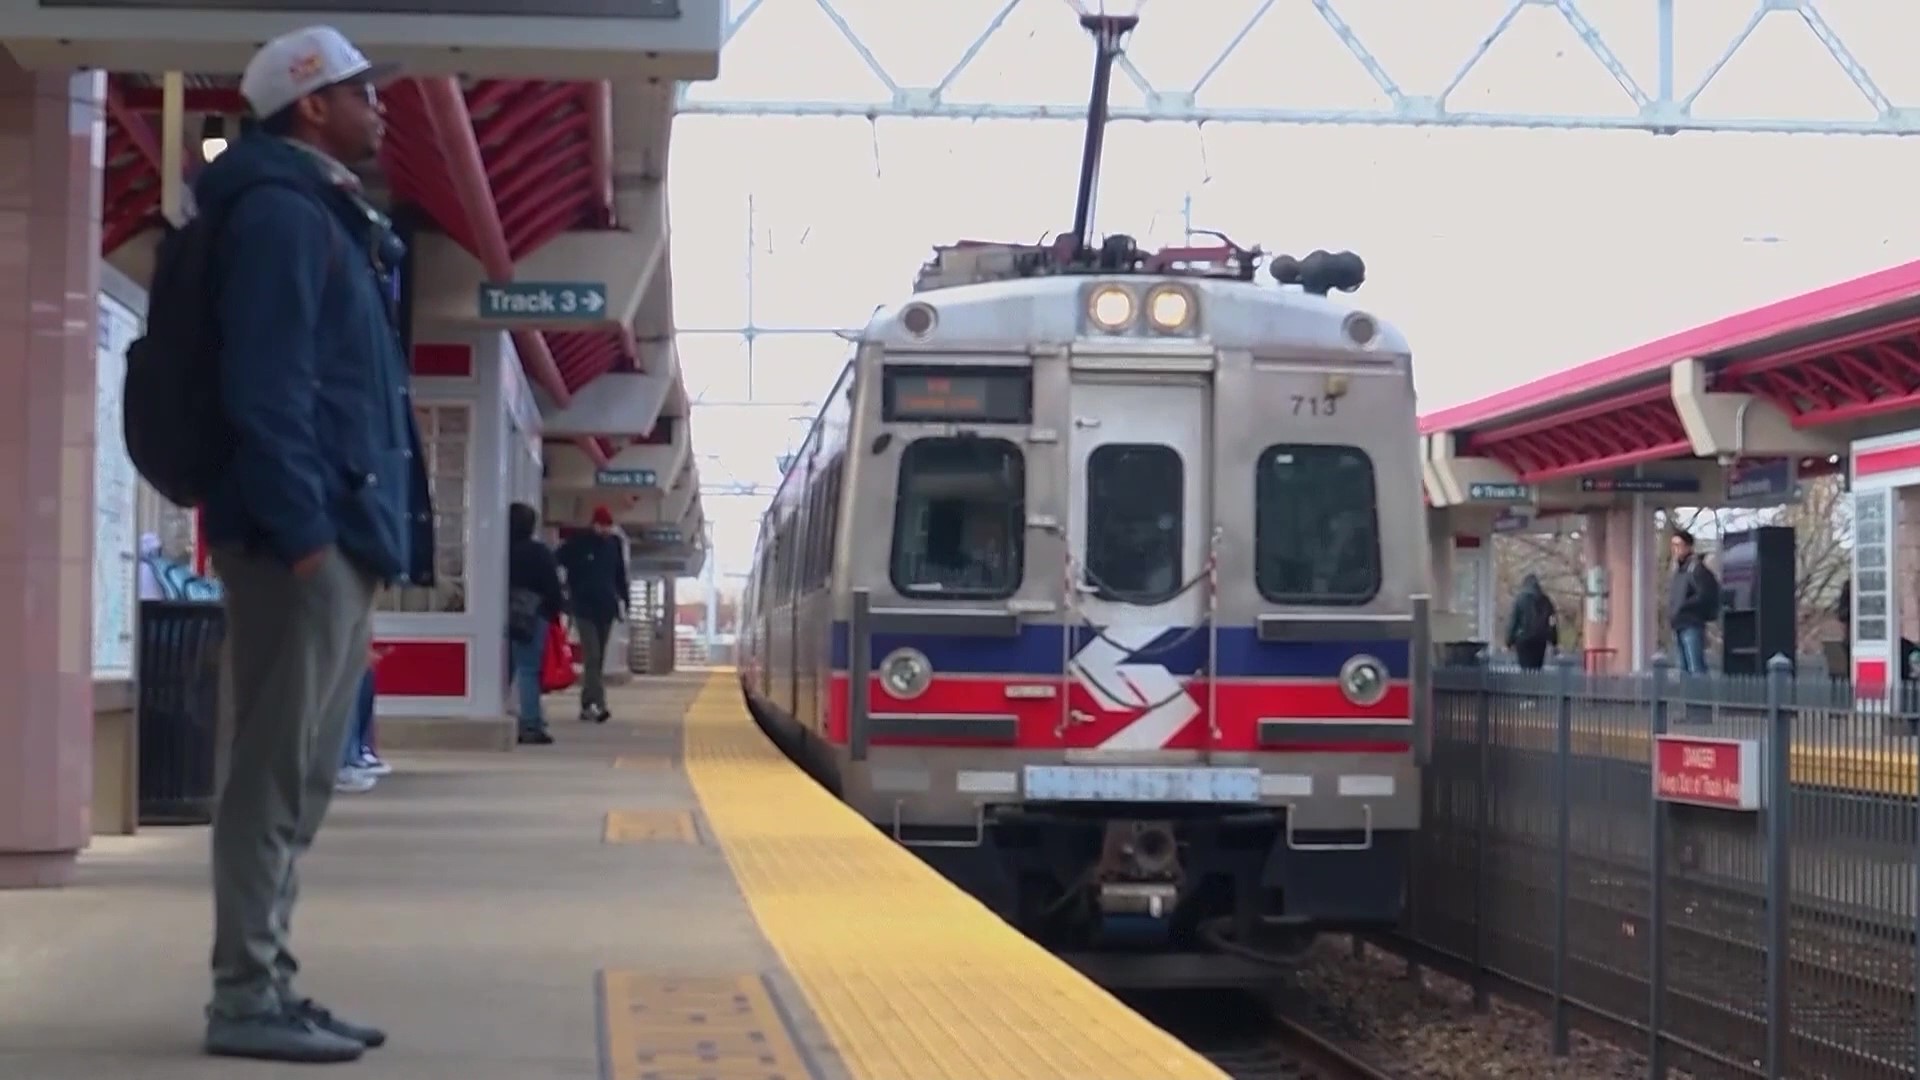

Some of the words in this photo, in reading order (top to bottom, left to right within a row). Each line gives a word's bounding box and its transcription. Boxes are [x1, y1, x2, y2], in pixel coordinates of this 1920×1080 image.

[487, 289, 555, 312] Track
[560, 290, 577, 312] 3
[1290, 394, 1336, 416] 713
